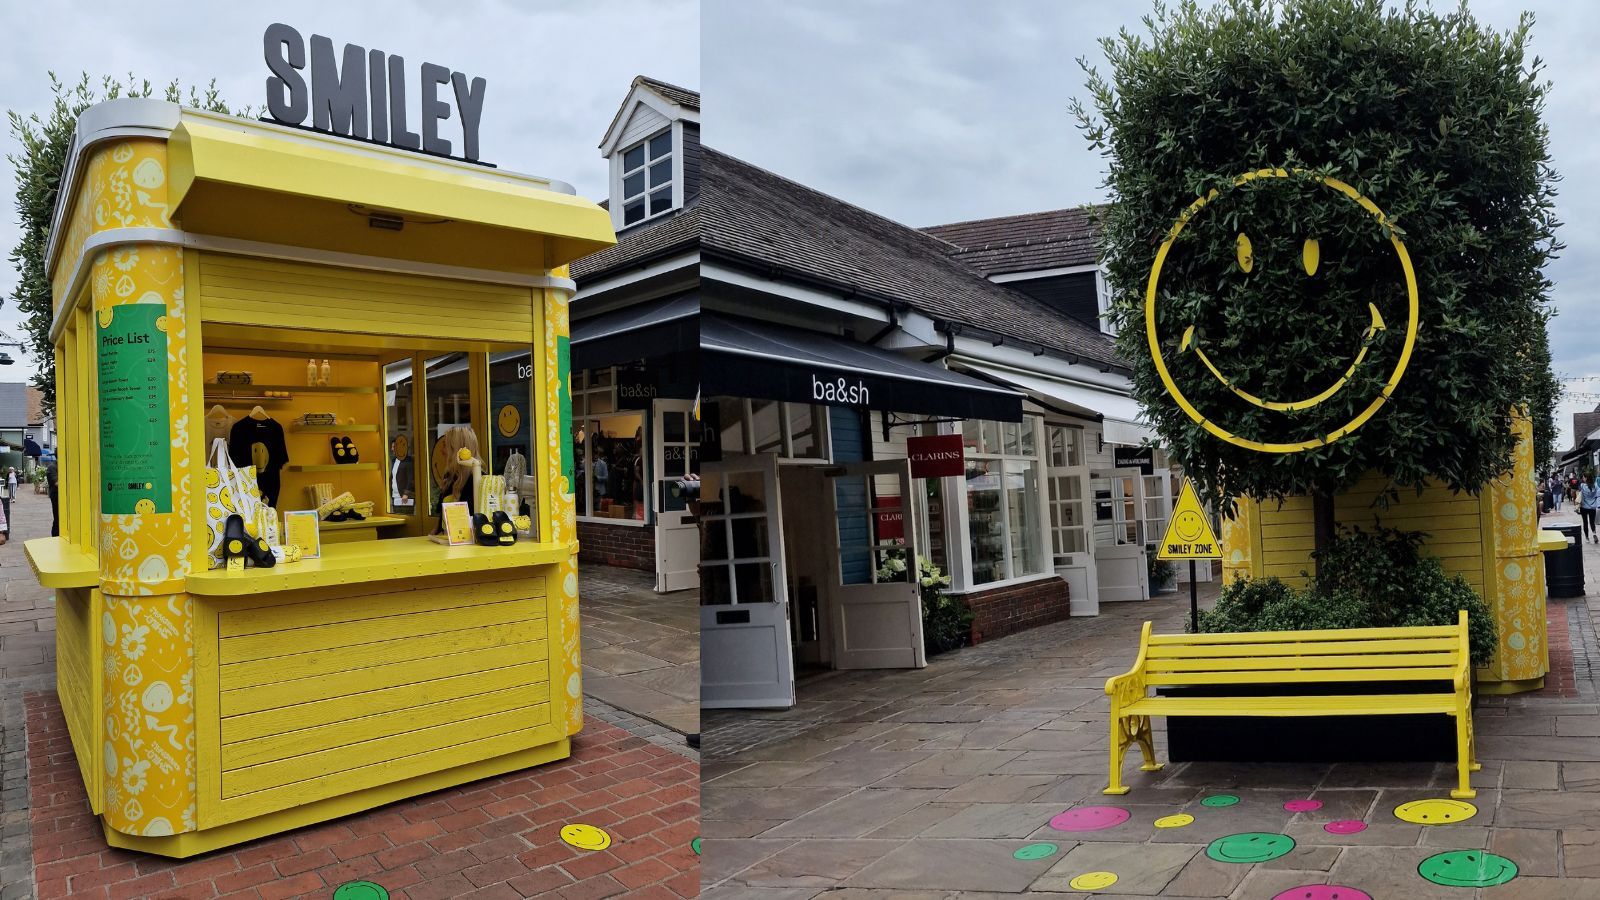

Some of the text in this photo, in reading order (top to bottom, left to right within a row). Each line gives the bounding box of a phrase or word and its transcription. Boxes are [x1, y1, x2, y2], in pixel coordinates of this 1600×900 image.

[264, 23, 486, 160] SMILEY
[103, 332, 149, 347] Price List
[620, 383, 657, 397] ba&sh
[812, 374, 869, 404] ba&sh
[911, 451, 960, 461] CLARINS
[1168, 544, 1213, 554] SMILEY ZONE
